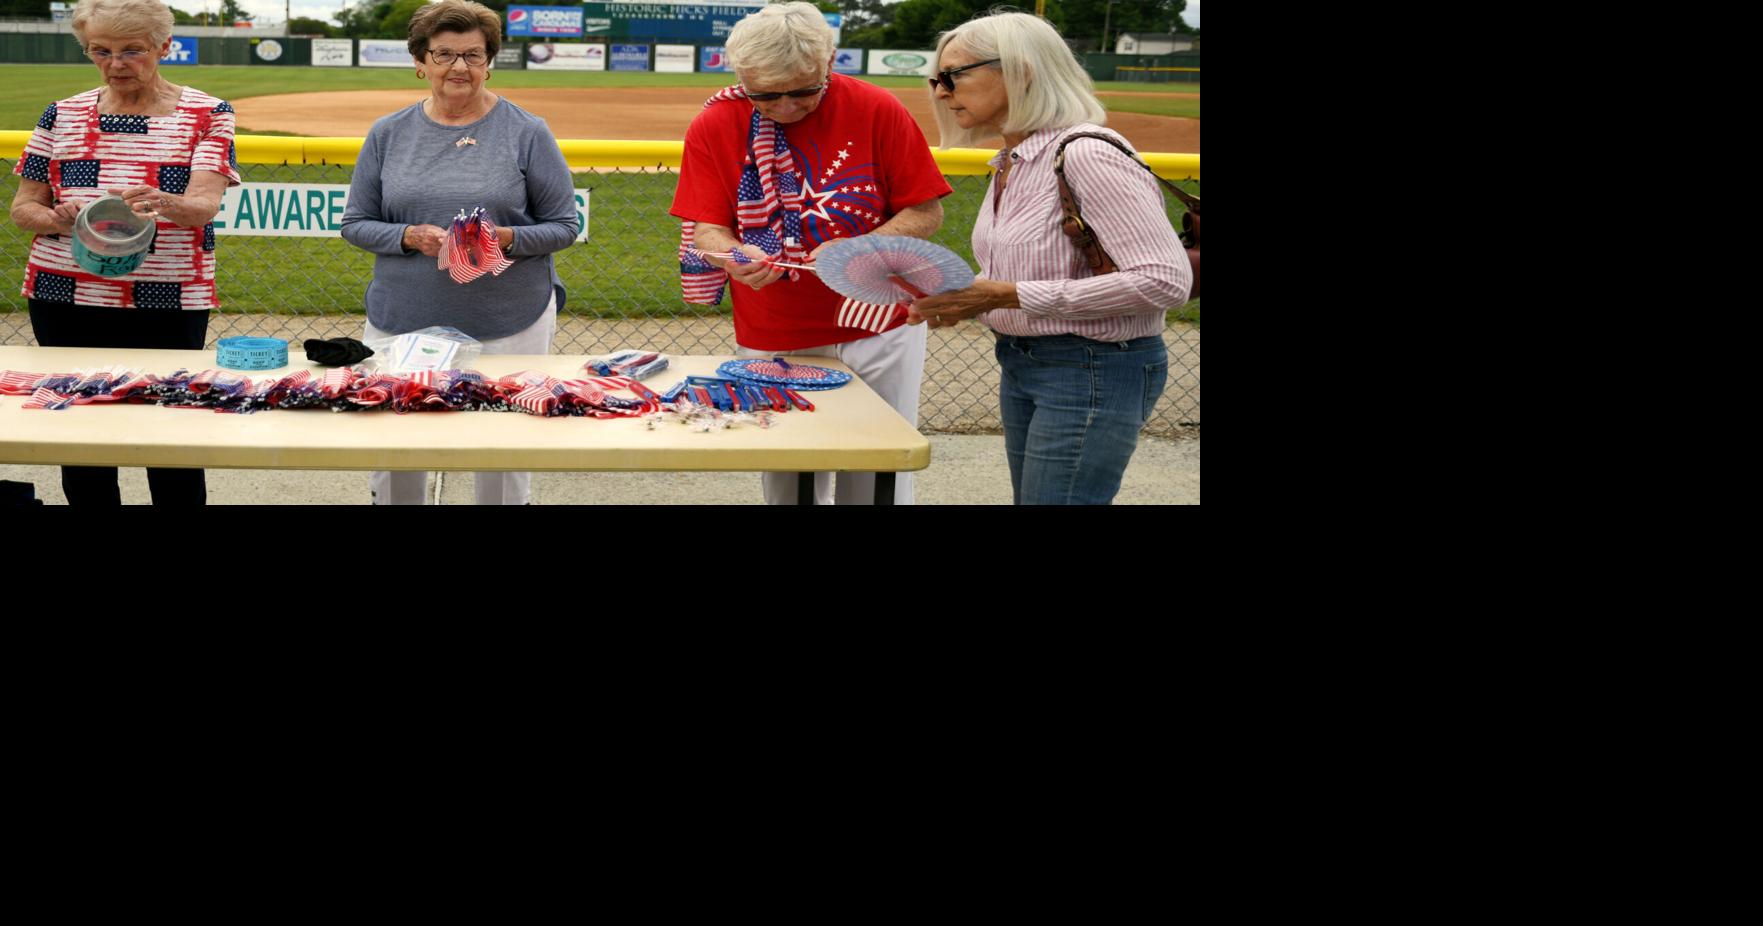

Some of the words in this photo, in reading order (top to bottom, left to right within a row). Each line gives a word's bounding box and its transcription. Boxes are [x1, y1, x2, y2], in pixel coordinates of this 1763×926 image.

[604, 4, 667, 14] HISTORIC
[669, 5, 708, 15] HICKS
[712, 7, 747, 16] FIELD
[234, 188, 346, 231] AWARE
